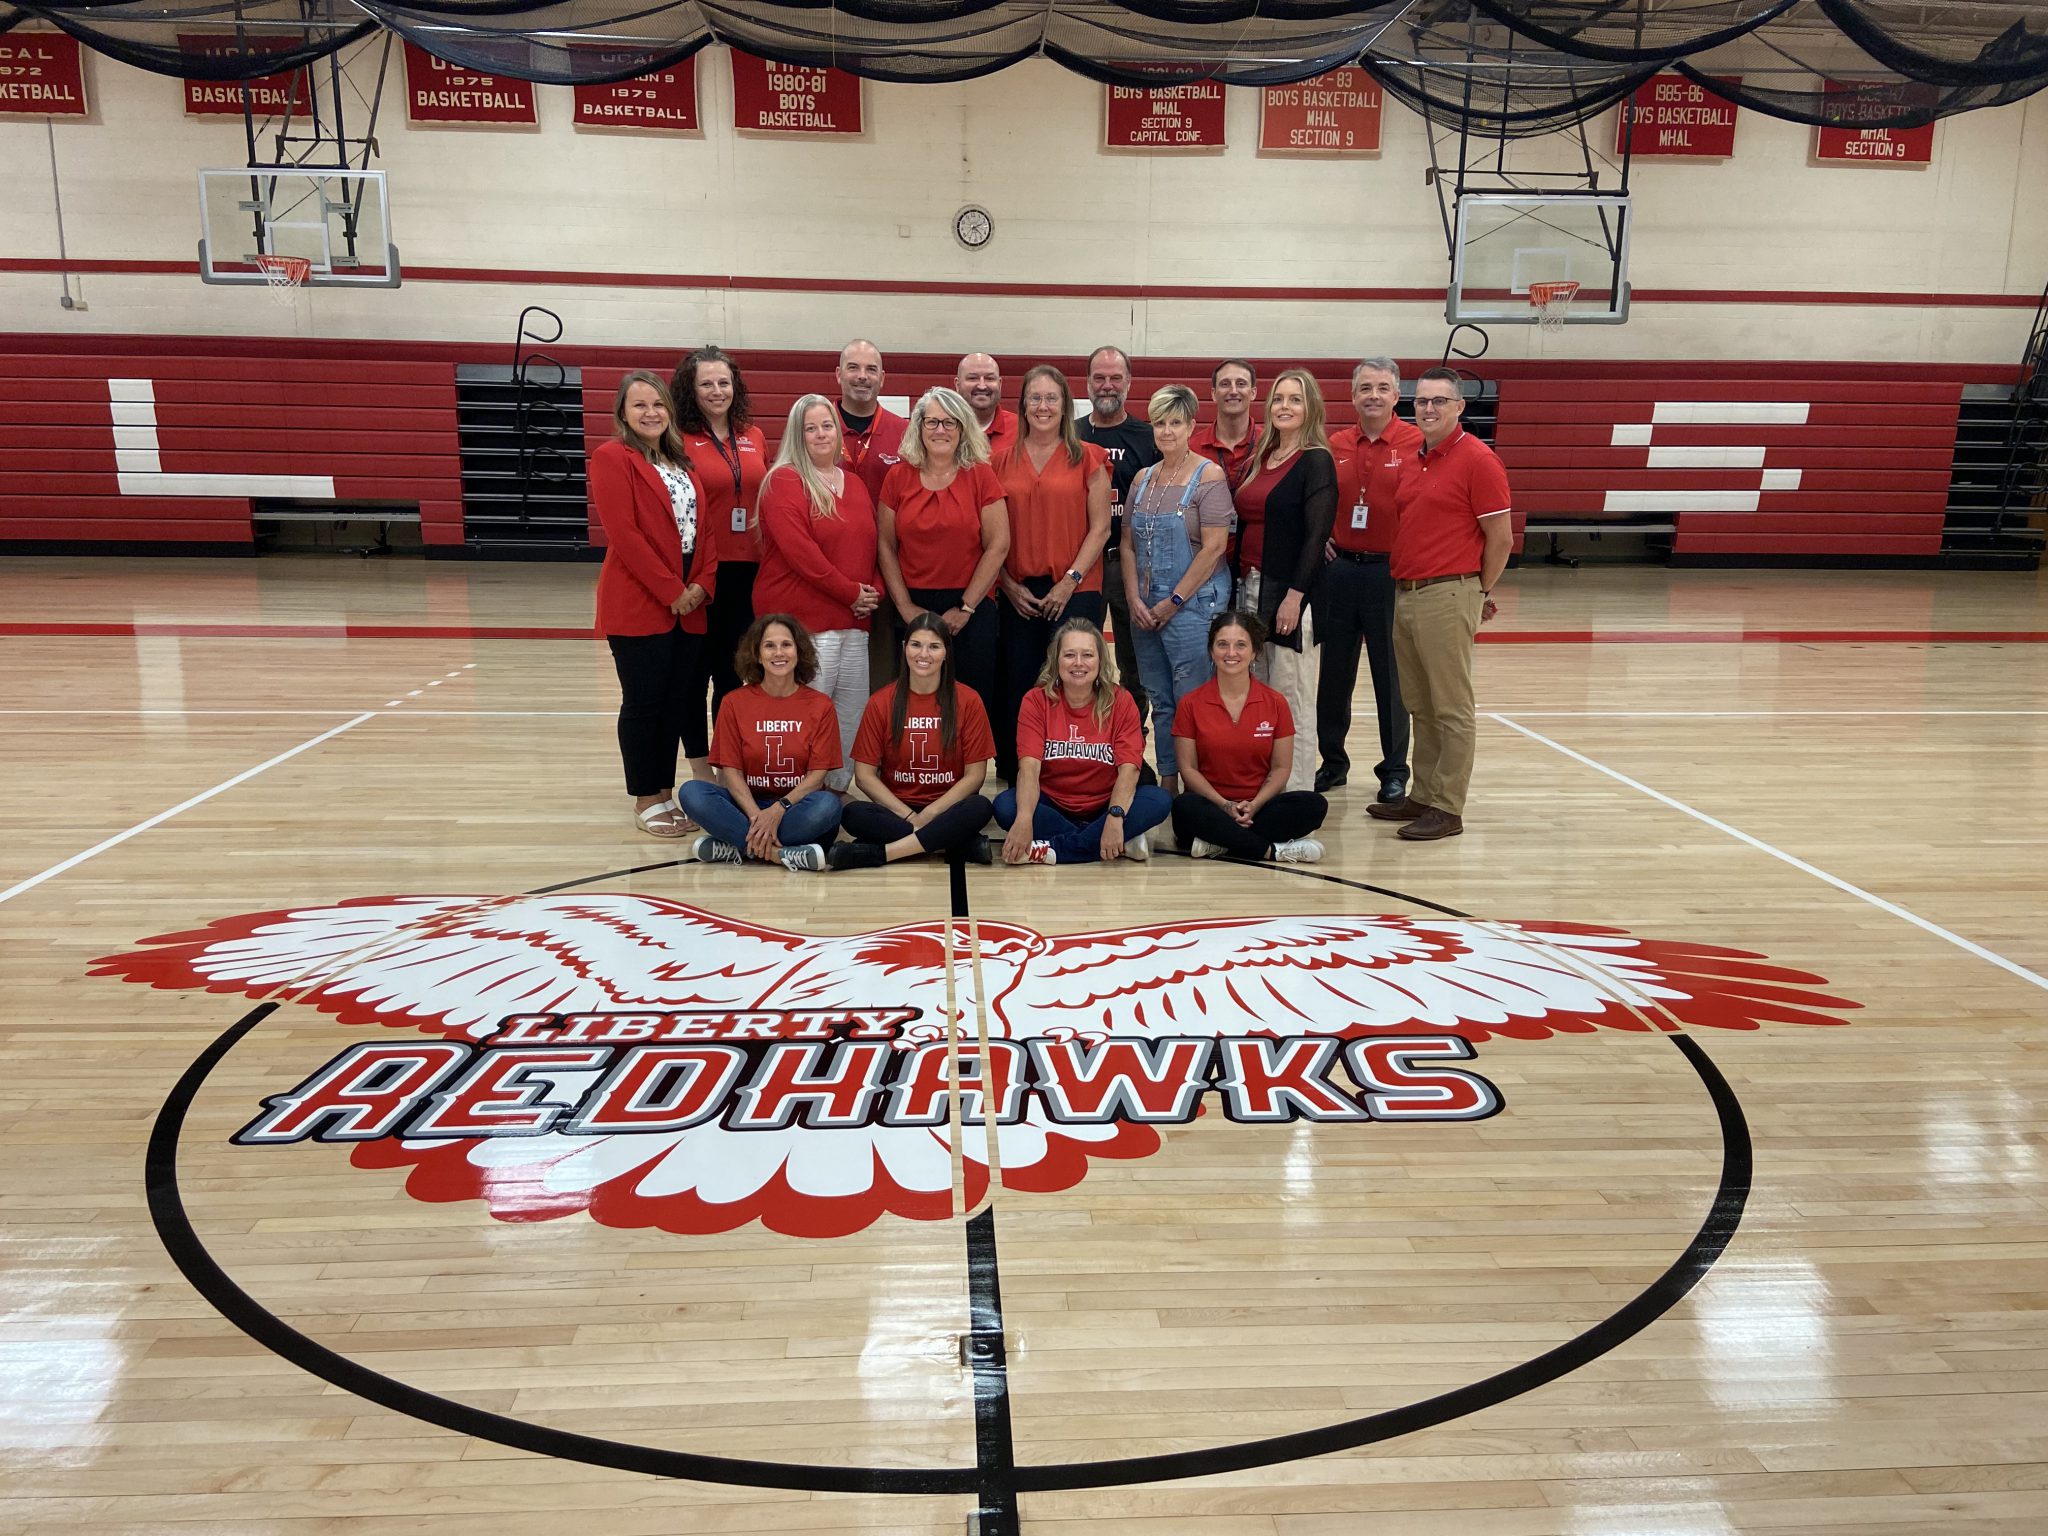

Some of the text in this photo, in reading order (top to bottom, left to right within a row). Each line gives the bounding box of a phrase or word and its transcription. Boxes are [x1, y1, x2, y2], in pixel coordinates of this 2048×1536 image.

[445, 76, 494, 86] 1975
[767, 73, 826, 93] 1980-81
[191, 86, 303, 105] BASKETBALL
[417, 90, 526, 109] BASKETBALL
[611, 88, 657, 99] 1976
[1113, 85, 1221, 99] BOYS BASKETBALL
[1267, 90, 1379, 108] BOYS BASKETBALL
[1655, 83, 1704, 103] 1985-86
[779, 93, 816, 111] BOYS
[1152, 101, 1181, 115] MHAL
[583, 103, 687, 120] BASKETBALL
[759, 110, 836, 128] BASKETBALL
[1306, 110, 1339, 127] MHAL
[1657, 106, 1733, 126] BASKETBALL
[1141, 117, 1193, 129] SECTION 9
[1130, 130, 1203, 142] CAPITAL CONF.
[1290, 129, 1354, 147] SECTION 9
[1658, 129, 1693, 147] MHAL
[1844, 141, 1906, 158] SECTION 9
[756, 720, 803, 733] LIBERTY
[1068, 724, 1085, 742] L
[764, 735, 795, 774] L
[909, 732, 939, 770] L
[1044, 739, 1115, 765] REDHAWKS
[746, 774, 770, 788] HIGH
[894, 770, 955, 785] HIGH SCHOOL
[494, 1011, 924, 1044] LIBERTY
[232, 1036, 1506, 1145] REDHAWKS
